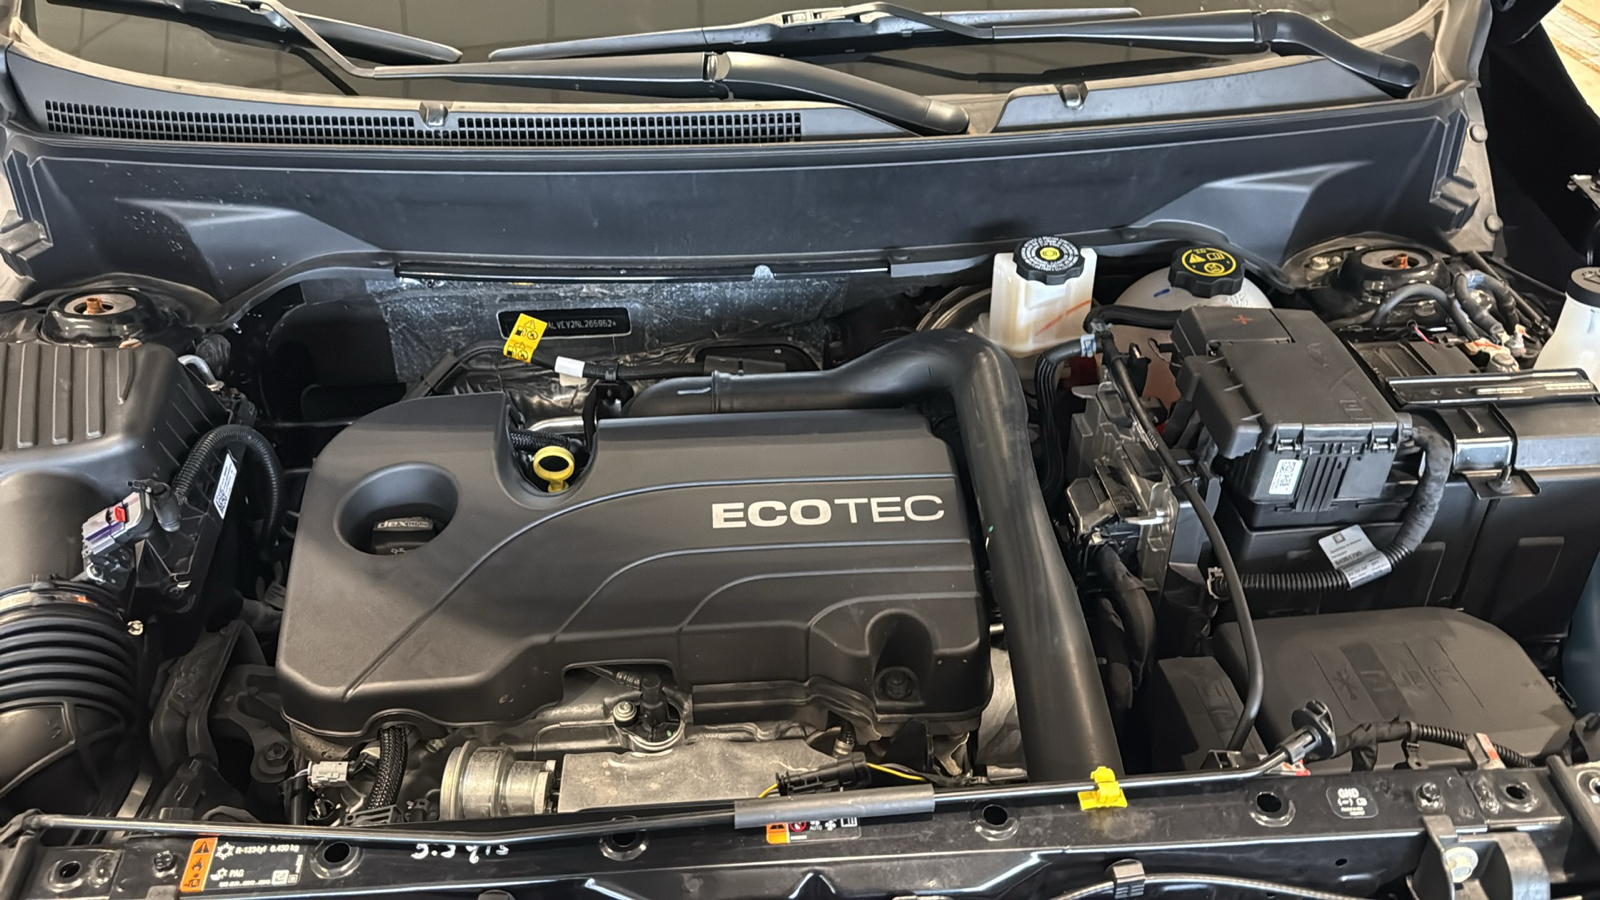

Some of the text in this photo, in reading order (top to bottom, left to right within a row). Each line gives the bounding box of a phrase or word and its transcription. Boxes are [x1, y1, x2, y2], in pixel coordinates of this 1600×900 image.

[711, 494, 945, 529] ECOTEC
[377, 520, 429, 529] dexos
[290, 843, 300, 853] kg
[229, 868, 245, 878] PAG
